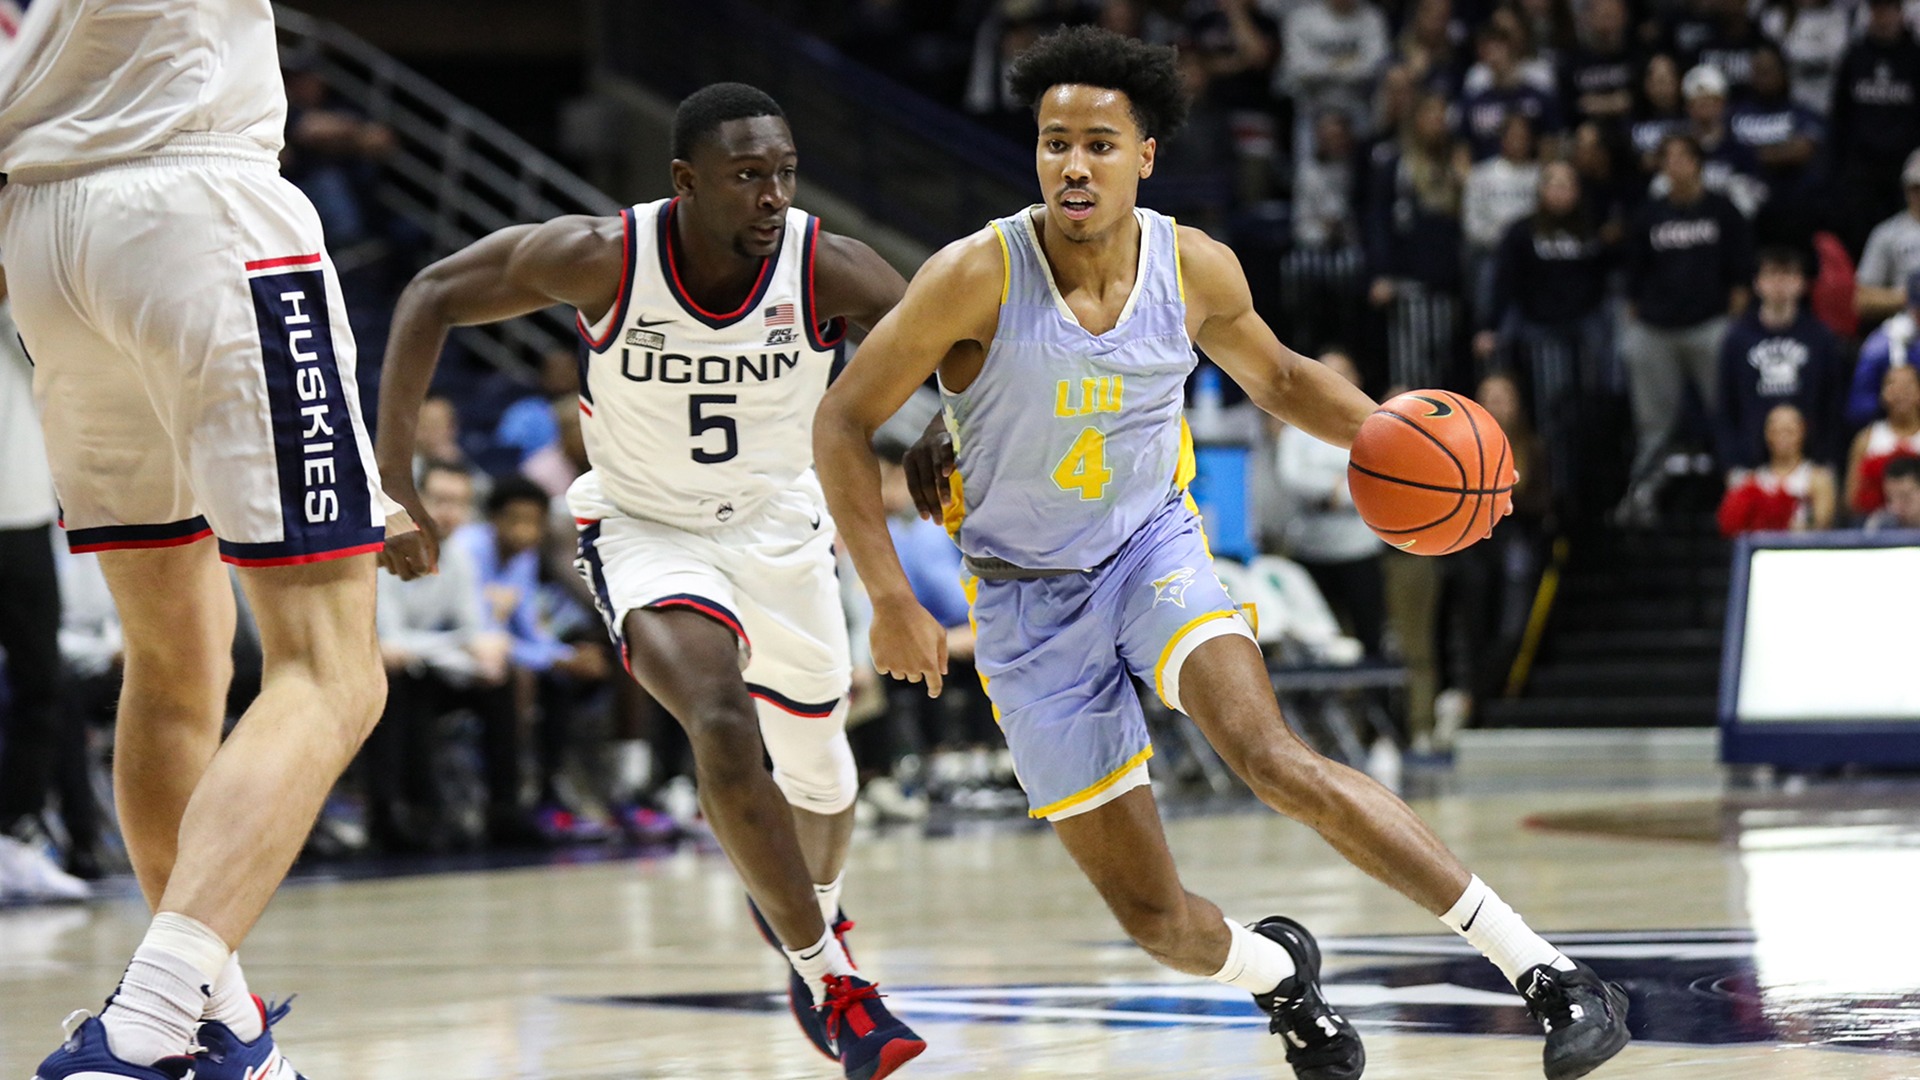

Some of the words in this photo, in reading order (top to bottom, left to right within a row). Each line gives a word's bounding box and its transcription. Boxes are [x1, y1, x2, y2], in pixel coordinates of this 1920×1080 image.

[621, 348, 800, 384] UCONN
[766, 333, 799, 343] EAST
[280, 290, 339, 524] HUSKIES
[1054, 374, 1124, 418] LIU
[688, 394, 738, 464] 5
[1050, 425, 1113, 501] 4
